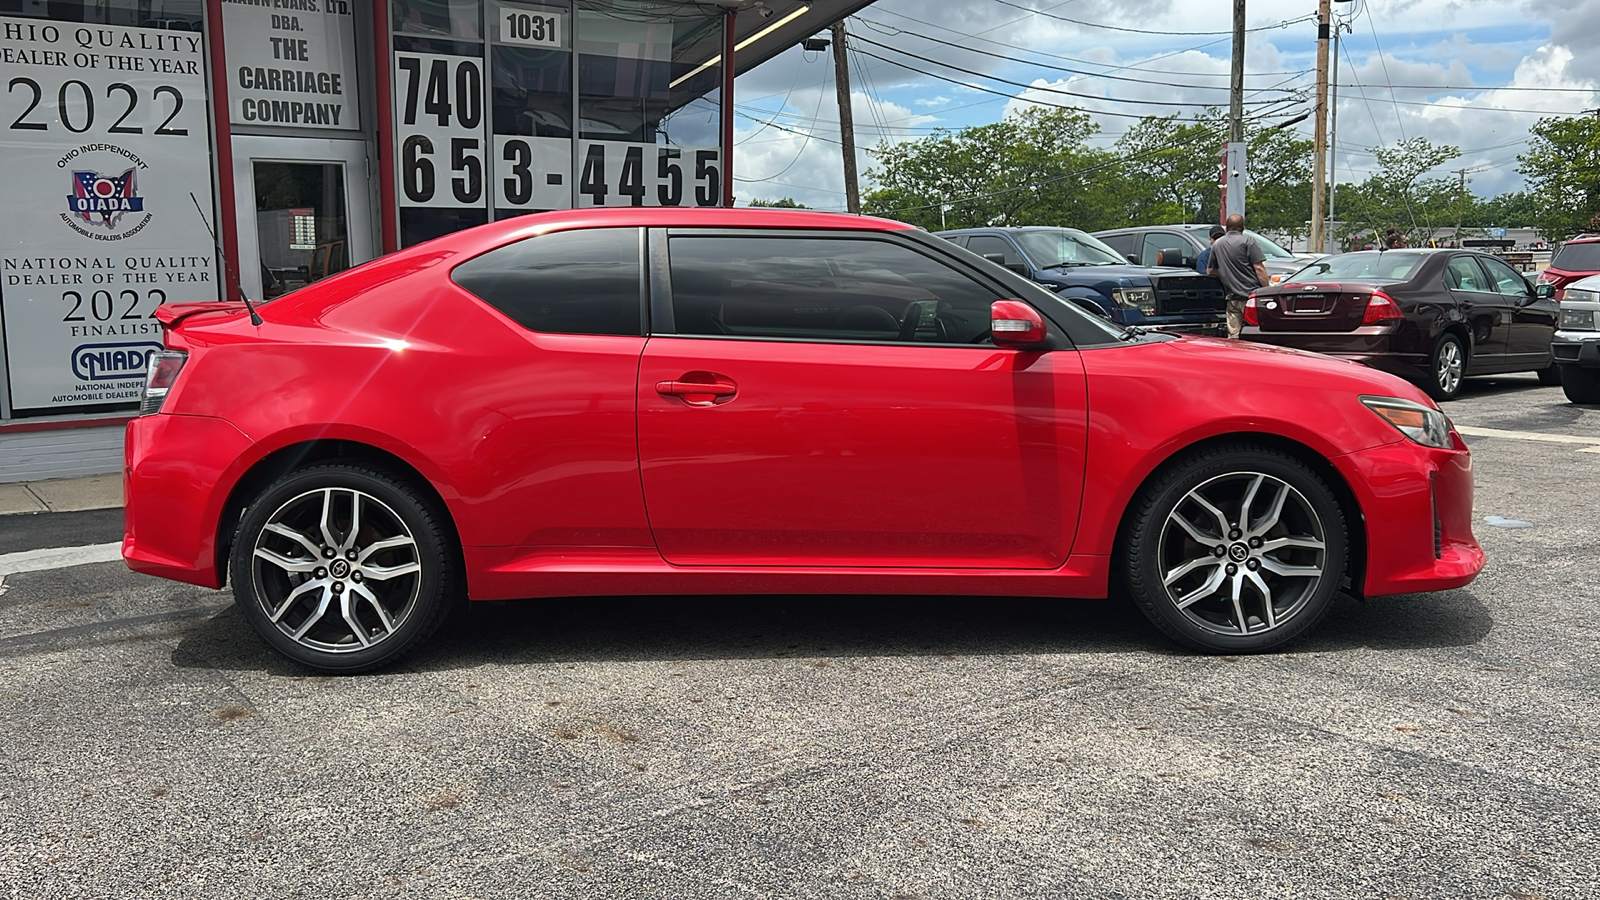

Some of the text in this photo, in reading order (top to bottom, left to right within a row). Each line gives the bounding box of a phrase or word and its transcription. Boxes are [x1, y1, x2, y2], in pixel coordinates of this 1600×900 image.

[325, 0, 351, 16] LTD.
[271, 14, 303, 31] DBA.
[506, 13, 556, 42] 1031
[3, 22, 200, 53] HIO QUALITY
[269, 37, 309, 61] THE
[0, 47, 199, 75] EALER OF THE YEAR
[239, 66, 342, 95] CARRIAGE
[399, 57, 481, 129] 740
[8, 77, 189, 137] 2022
[242, 98, 342, 126] COMPANY
[57, 143, 148, 170] OHIO INDEPENDENT
[77, 198, 132, 211] OIADA
[59, 212, 153, 241] AUTOMOBILE DEALERS ASSOCIATION
[4, 256, 211, 270] NATIONAL QUALITY
[8, 271, 210, 286] DEALER OF THE YEAR
[61, 289, 167, 322] 2022
[71, 323, 160, 337] FINALIST
[52, 393, 104, 403] AUTOMOBILE
[105, 391, 139, 399] DEALERS
[75, 381, 144, 391] NATIONAL INDEPE
